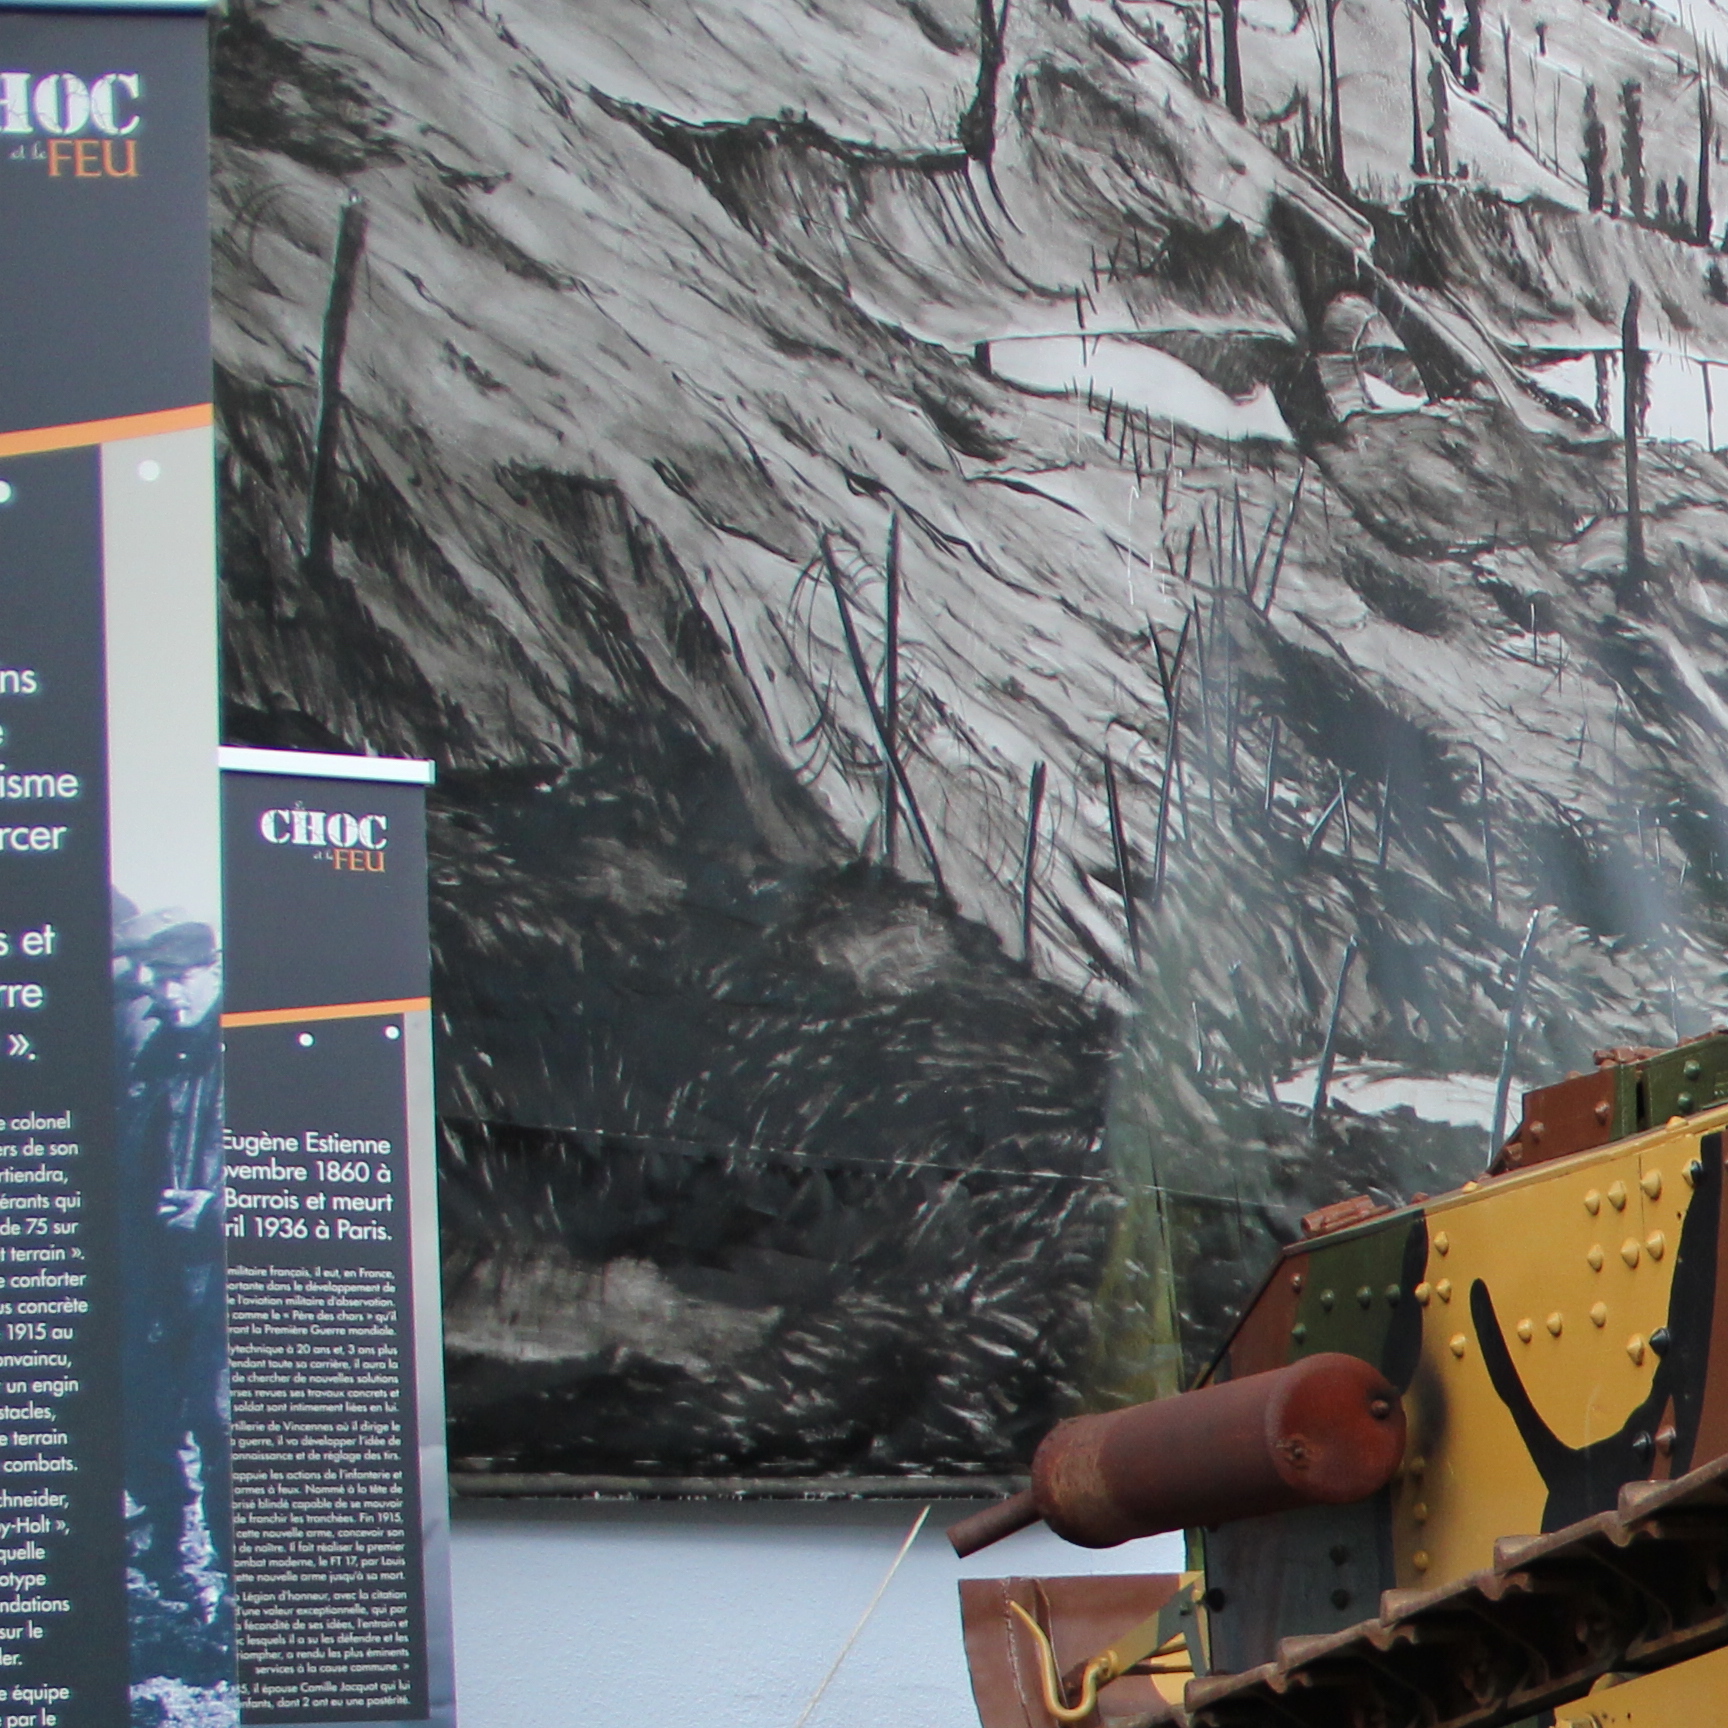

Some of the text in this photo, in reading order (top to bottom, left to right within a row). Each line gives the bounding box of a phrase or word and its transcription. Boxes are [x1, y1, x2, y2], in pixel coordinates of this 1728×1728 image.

[48, 139, 139, 176] FEU
[261, 809, 388, 849] CHOC
[334, 849, 385, 872] FEU
[22, 924, 55, 955] et
[11, 1111, 70, 1130] colonel
[23, 1138, 44, 1156] de
[50, 1143, 78, 1155] son
[223, 1128, 391, 1157] Eugène Estienne
[316, 1161, 370, 1183] 1860
[377, 1164, 391, 1183] à
[55, 1191, 81, 1212] qui
[225, 1188, 393, 1211] Barrois et meurt
[26, 1218, 47, 1235] 75
[53, 1223, 78, 1234] sur
[255, 1217, 308, 1239] 1936
[315, 1220, 330, 1239] à
[337, 1218, 392, 1240] Paris.
[11, 1245, 65, 1261] terrain
[11, 1269, 86, 1288] conforter
[228, 1265, 267, 1277] militaire
[270, 1266, 311, 1278] français,
[359, 1268, 395, 1280] France,
[18, 1296, 88, 1314] concrète
[7, 1323, 73, 1340] 1915 au
[7, 1376, 78, 1397] un engin
[232, 1372, 398, 1384] de chercher de nouvelles solutions
[13, 1429, 67, 1446] terrain
[3, 1453, 78, 1472] combats.
[250, 1513, 287, 1523] franchir
[291, 1513, 304, 1523] les
[306, 1513, 356, 1523] tranchées.
[359, 1513, 374, 1522] Fin
[378, 1513, 404, 1522] 1915,
[28, 1620, 43, 1638] le
[255, 1663, 294, 1674] services
[307, 1663, 317, 1673] la
[320, 1665, 347, 1673] cause
[350, 1664, 400, 1672] commune.
[12, 1684, 69, 1704] équipe
[41, 1708, 56, 1726] le
